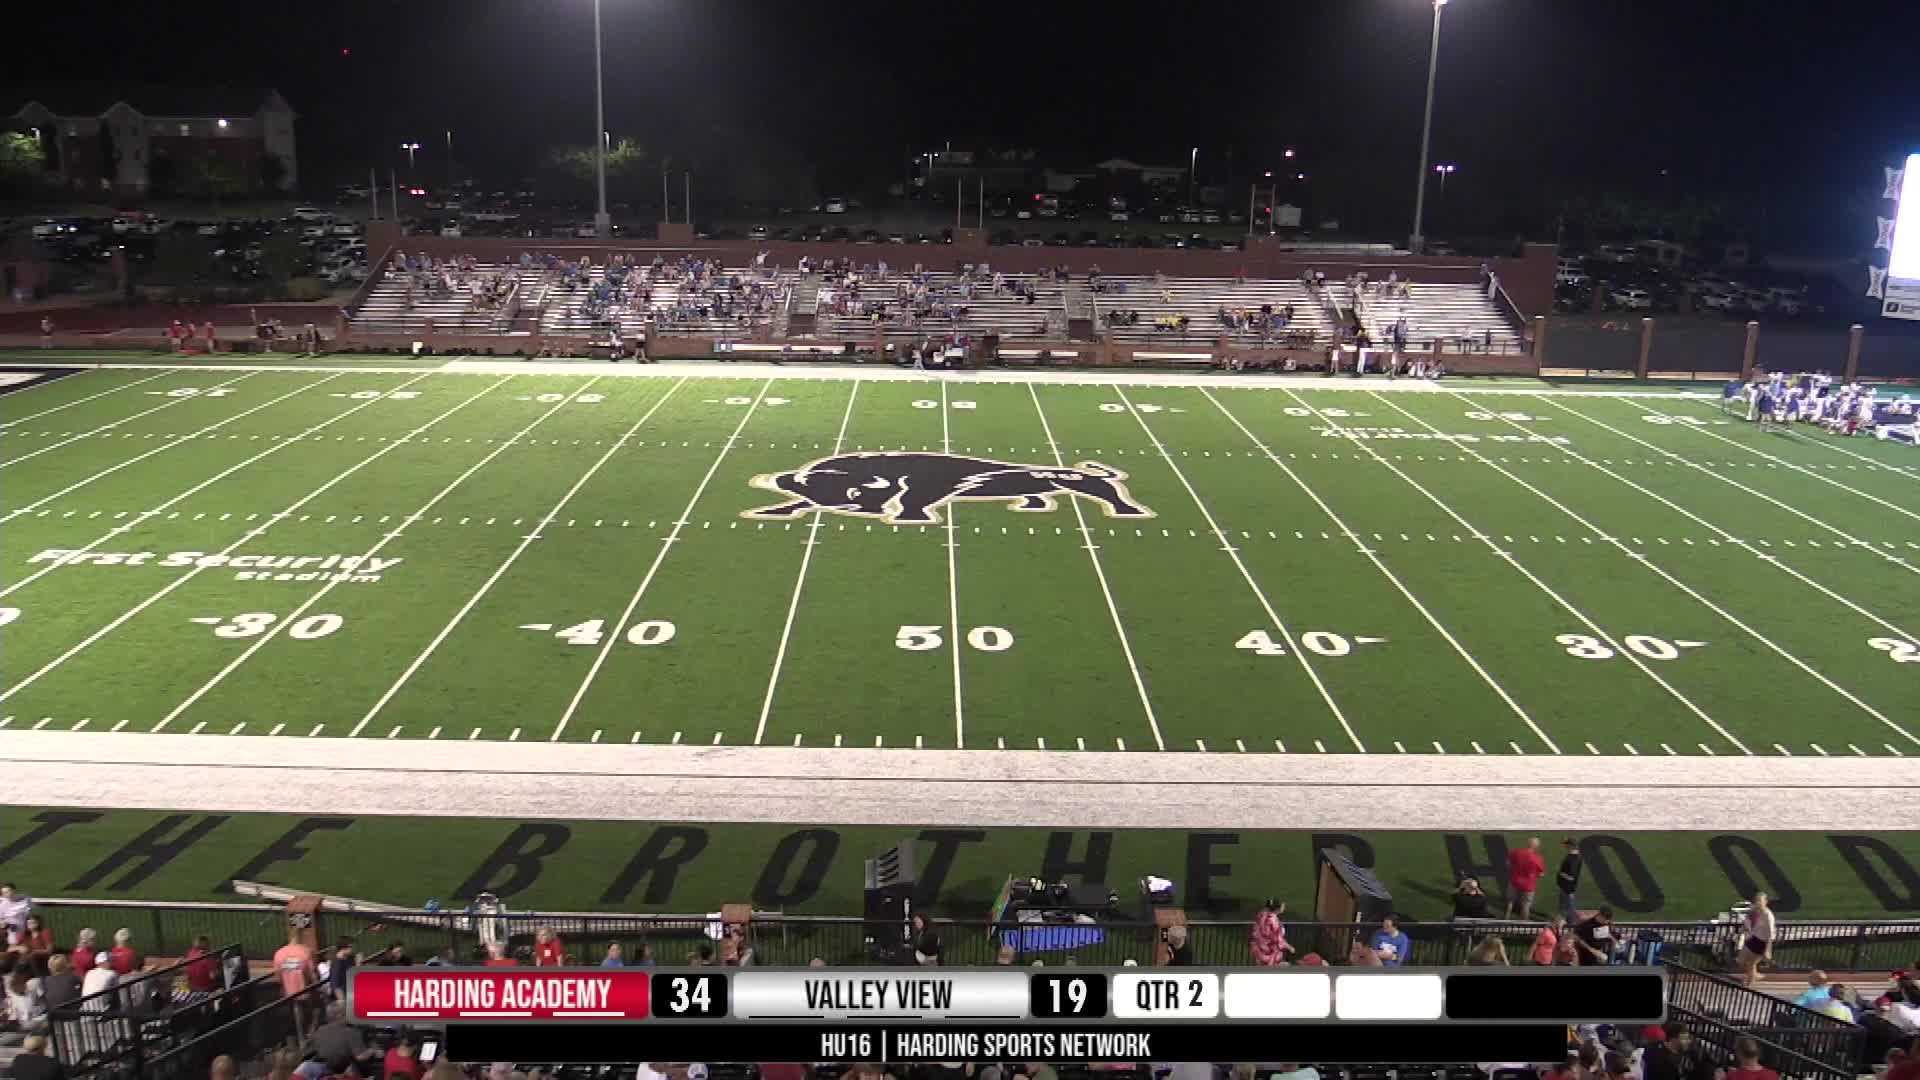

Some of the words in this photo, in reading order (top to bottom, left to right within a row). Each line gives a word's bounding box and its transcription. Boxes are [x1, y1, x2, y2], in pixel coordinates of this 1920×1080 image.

[26, 549, 156, 565] First
[158, 552, 403, 573] Security
[234, 571, 383, 583] Stadium
[214, 612, 344, 639] 30
[554, 618, 677, 646] 40
[894, 625, 1015, 652] 50
[1233, 629, 1352, 657] 40
[1554, 632, 1679, 661] 30
